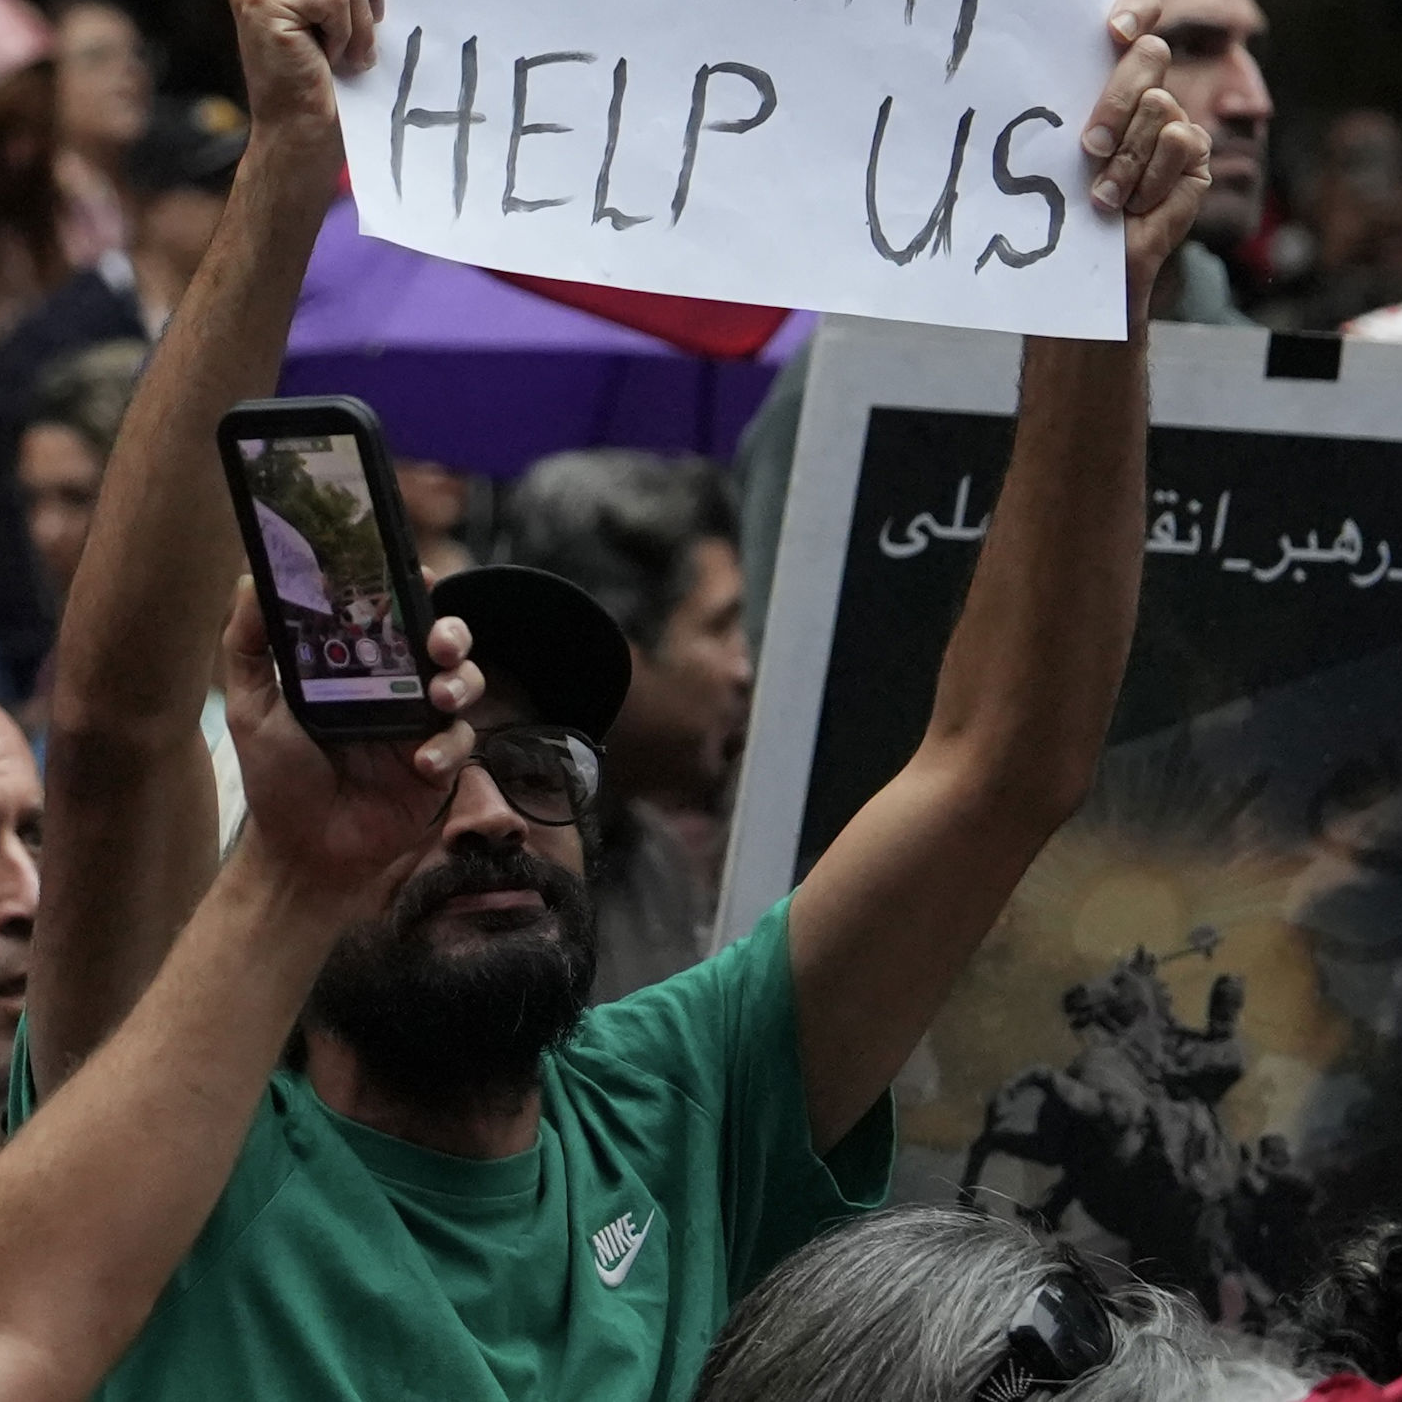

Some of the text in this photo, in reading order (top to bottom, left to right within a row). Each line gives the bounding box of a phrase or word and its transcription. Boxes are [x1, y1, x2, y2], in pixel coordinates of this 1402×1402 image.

[390, 25, 1067, 275] HELP US
[591, 1211, 641, 1268] NIKE
